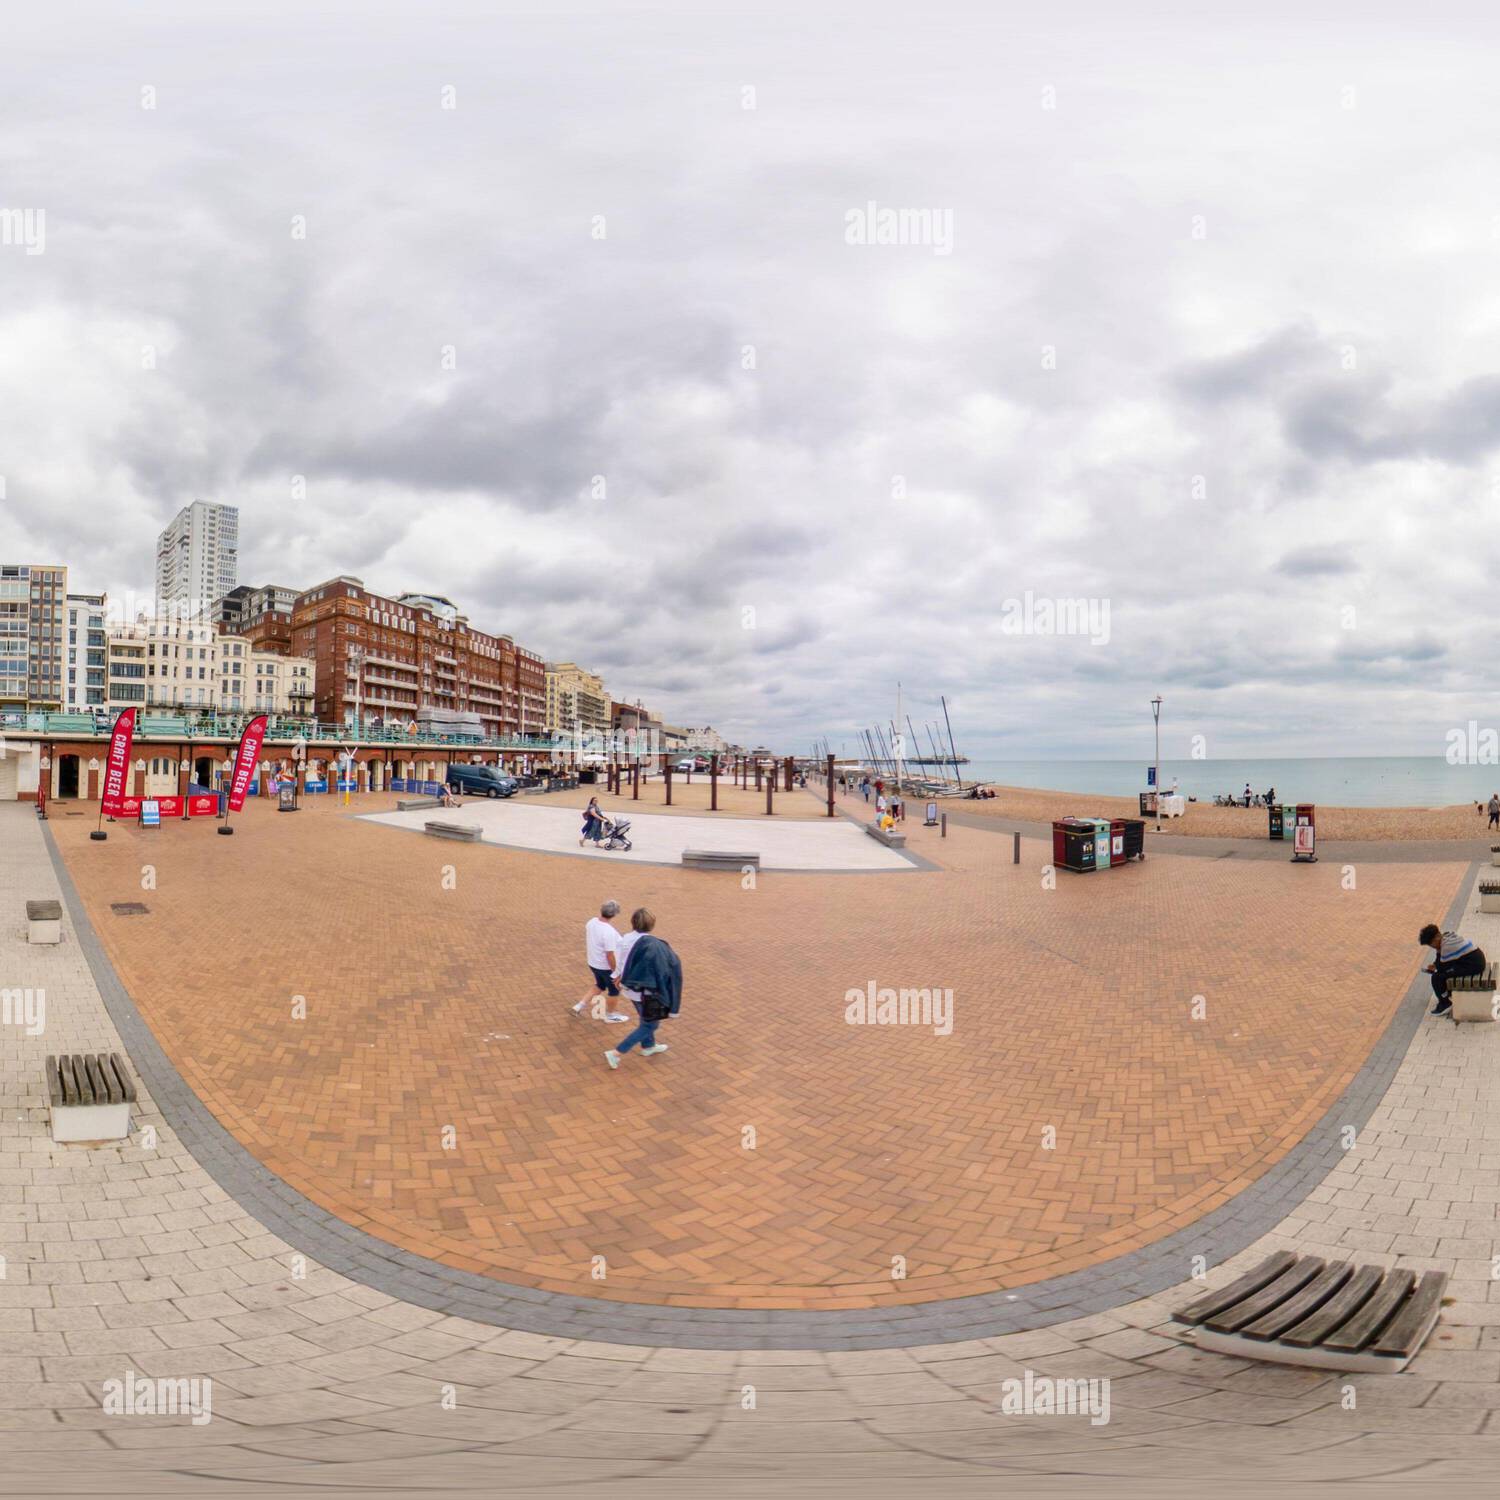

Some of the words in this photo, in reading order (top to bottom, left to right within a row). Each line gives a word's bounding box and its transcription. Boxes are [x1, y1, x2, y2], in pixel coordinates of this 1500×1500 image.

[111, 733, 127, 768] CRAFT
[242, 738, 257, 769] CRAFT
[107, 770, 122, 797] BEER
[233, 770, 250, 794] BEER
